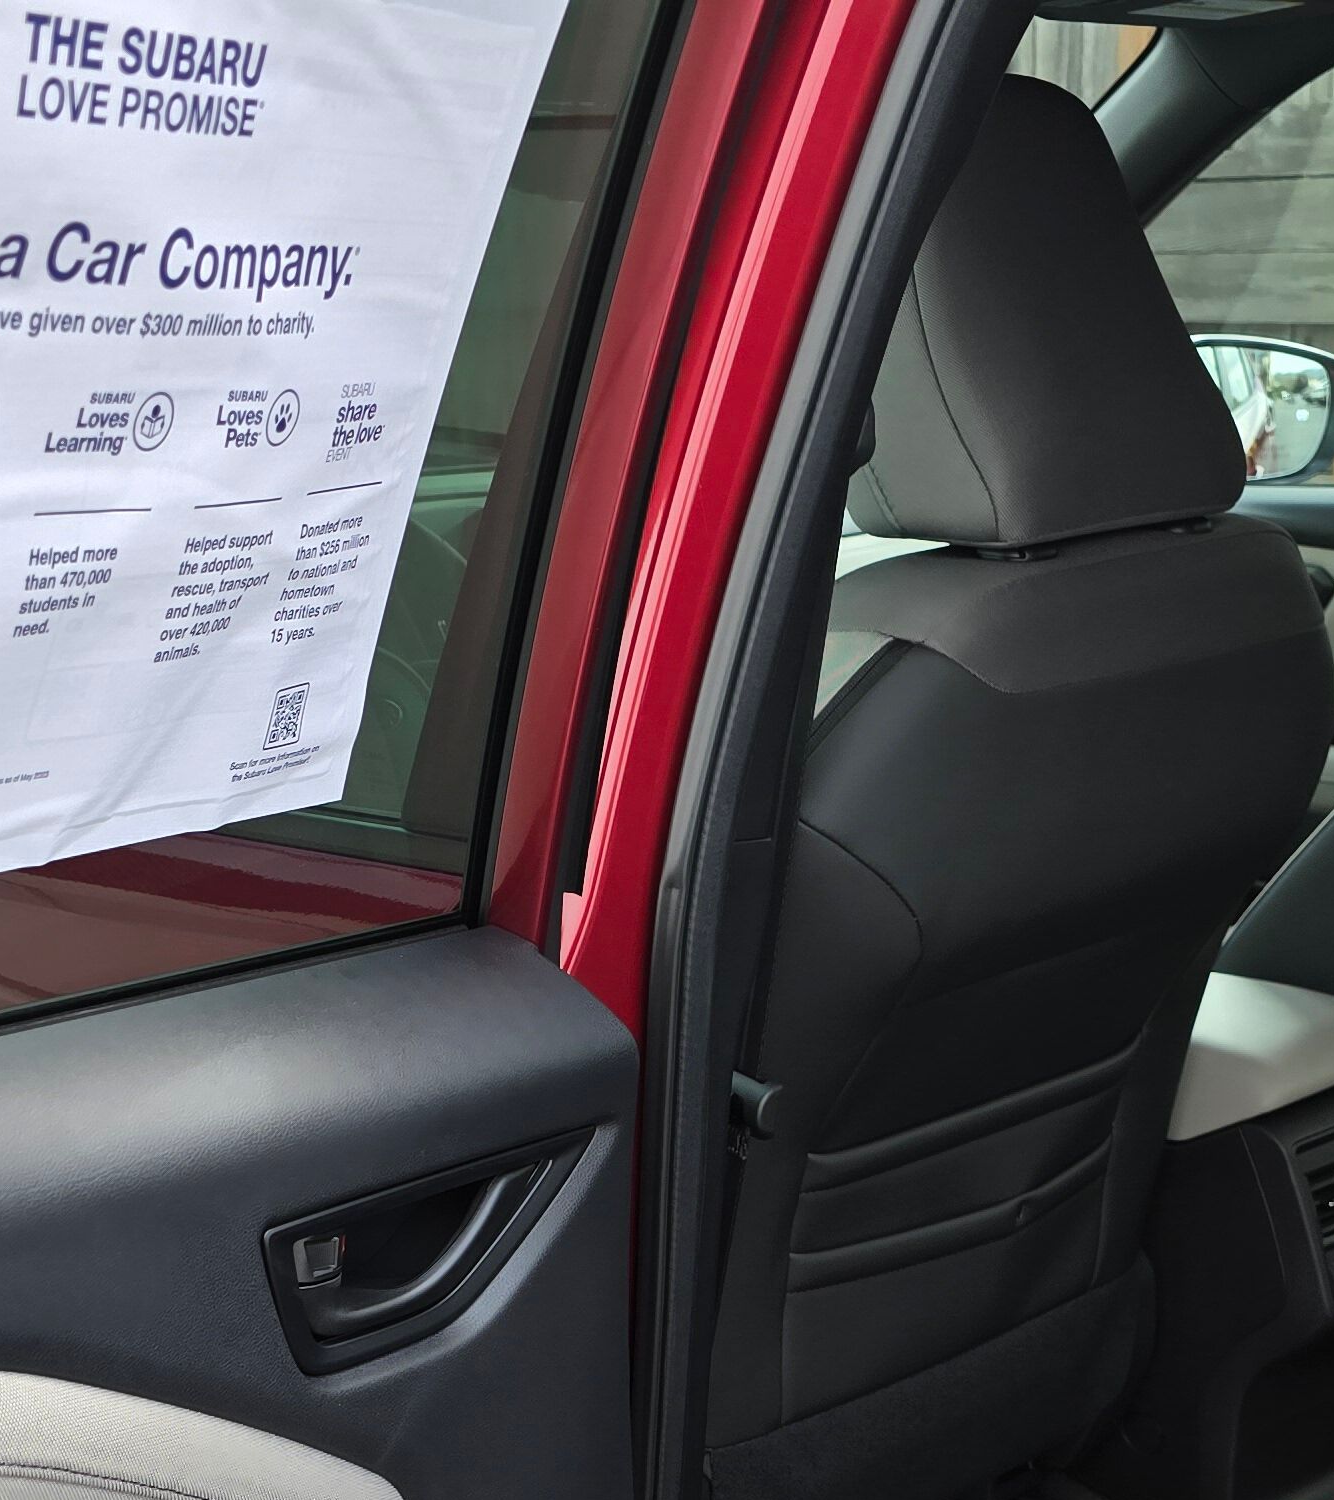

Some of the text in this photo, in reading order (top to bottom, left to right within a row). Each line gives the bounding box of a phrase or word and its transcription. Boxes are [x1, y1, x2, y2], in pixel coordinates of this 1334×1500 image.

[25, 13, 268, 89] THE SUBARU
[16, 75, 259, 137] LOVE PROMISE
[46, 221, 147, 286] Car
[159, 227, 353, 303] Company.
[29, 307, 84, 338] given
[91, 315, 133, 336] over
[139, 313, 183, 338] $300
[186, 313, 242, 337] million
[246, 315, 262, 336] to
[266, 313, 315, 339] charity.
[90, 392, 135, 404] SUBARU
[228, 390, 268, 402] SUBARU
[341, 382, 376, 398] SUBARU
[76, 407, 129, 428] Loves
[217, 405, 263, 426] Loves
[336, 400, 377, 423] share
[44, 432, 124, 456] Learning
[225, 428, 258, 448] Pets
[332, 425, 354, 447] the
[326, 447, 352, 462] EVENT
[300, 516, 363, 539] Donated more
[184, 530, 273, 555] Helped support
[295, 546, 317, 561] than
[29, 546, 117, 569] Helped more
[178, 554, 254, 576] the adoption,
[287, 555, 358, 581] to national and
[24, 568, 111, 591] than 470,000
[171, 572, 270, 598] rescue, transport
[19, 592, 95, 614] students in
[280, 584, 335, 601] hometown
[165, 594, 243, 620] and health of
[274, 601, 343, 621] charities over
[12, 619, 49, 638] need.
[159, 616, 231, 641] over 420,000
[271, 626, 315, 646] 15 years.
[154, 642, 200, 663] animals.
